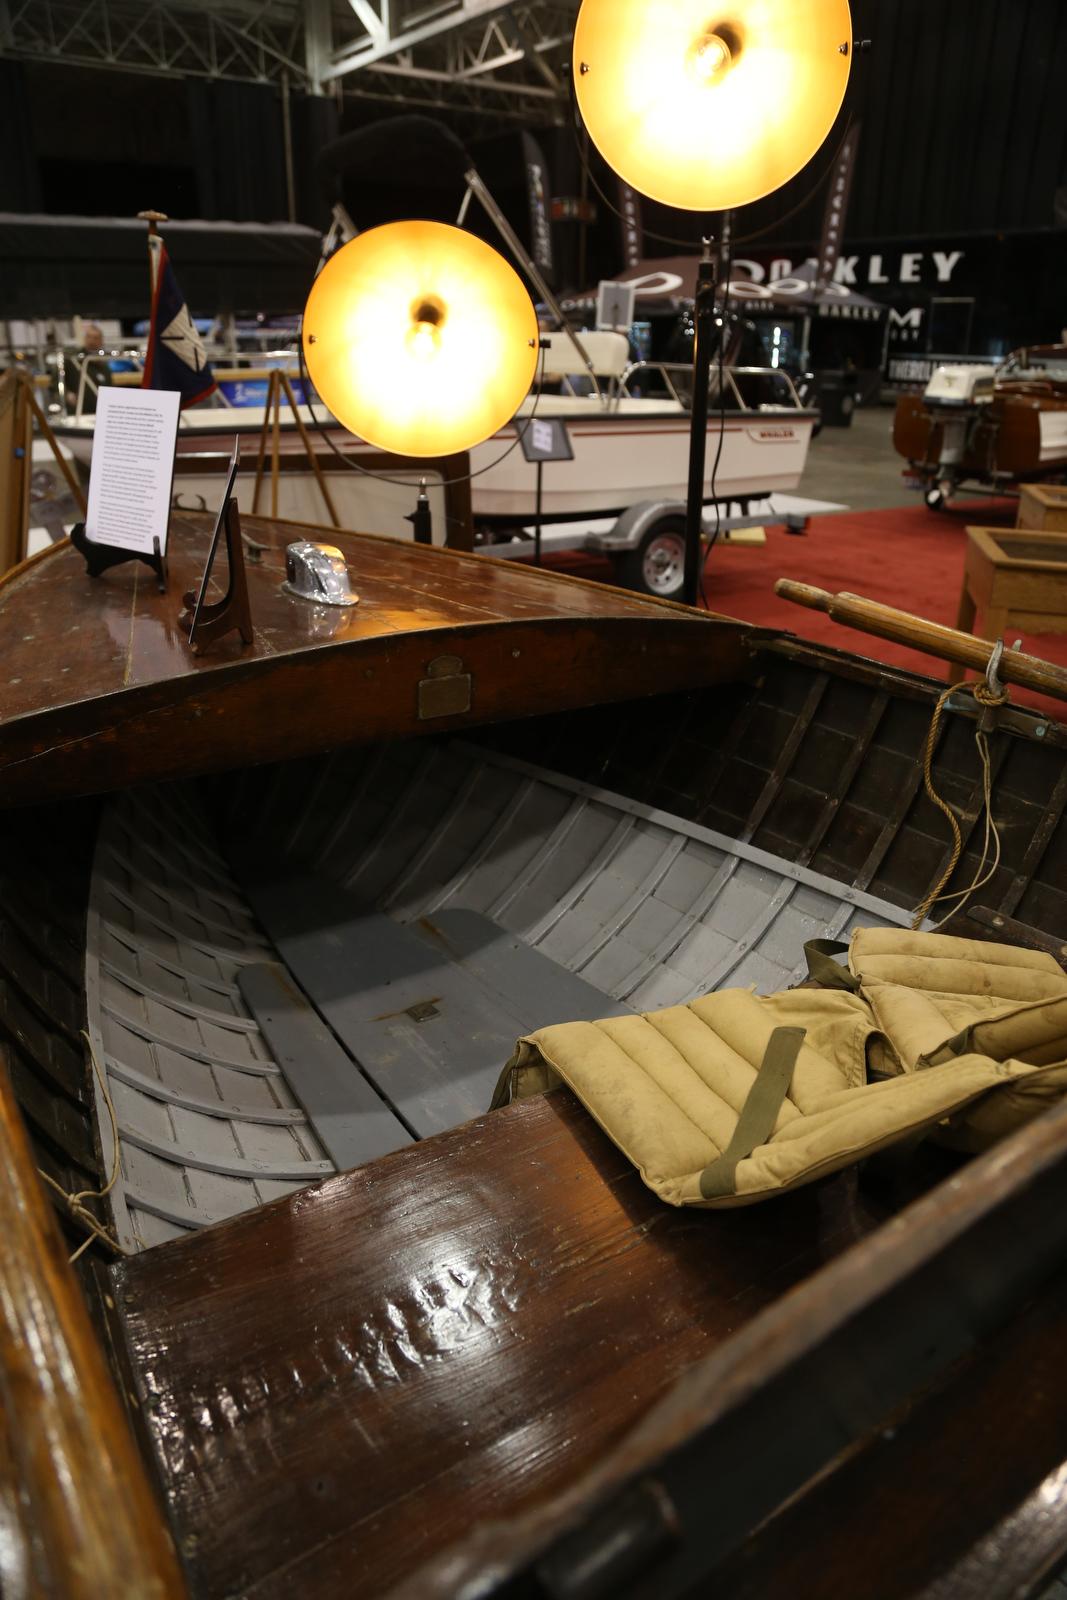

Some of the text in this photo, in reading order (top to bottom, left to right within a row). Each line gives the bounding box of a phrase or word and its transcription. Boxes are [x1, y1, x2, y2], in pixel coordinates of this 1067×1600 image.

[769, 251, 963, 284] OKLEY
[819, 304, 882, 321] OAKLEY
[760, 431, 794, 439] WHALER
